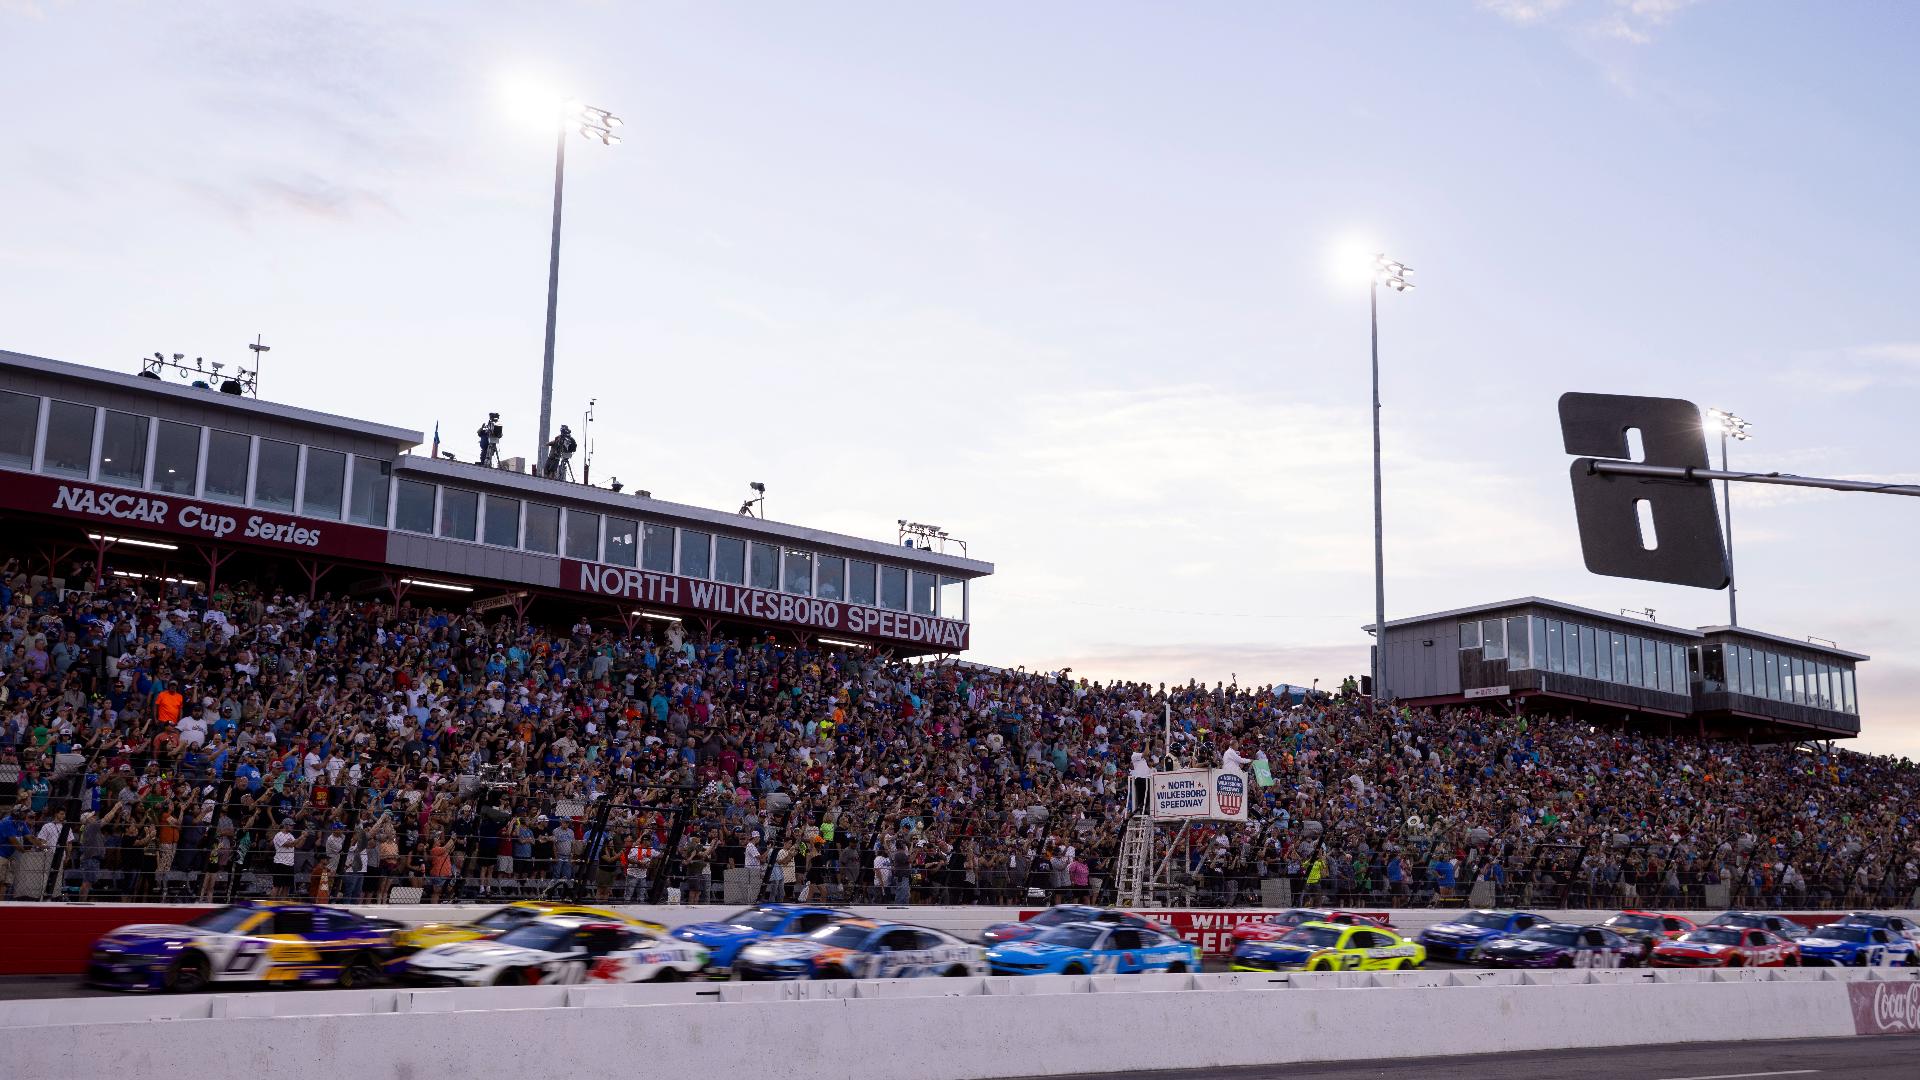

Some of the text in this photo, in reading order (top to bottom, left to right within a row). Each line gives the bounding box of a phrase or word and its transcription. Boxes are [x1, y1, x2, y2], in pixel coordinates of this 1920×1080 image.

[52, 485, 320, 547] NASCAR Cup Series
[580, 564, 968, 648] NORTH WILKESBORO SPEEDWAY
[1168, 781, 1195, 790] NORTH
[1157, 789, 1207, 799] WILKESBORO
[1160, 799, 1203, 809] SPEEDWAY
